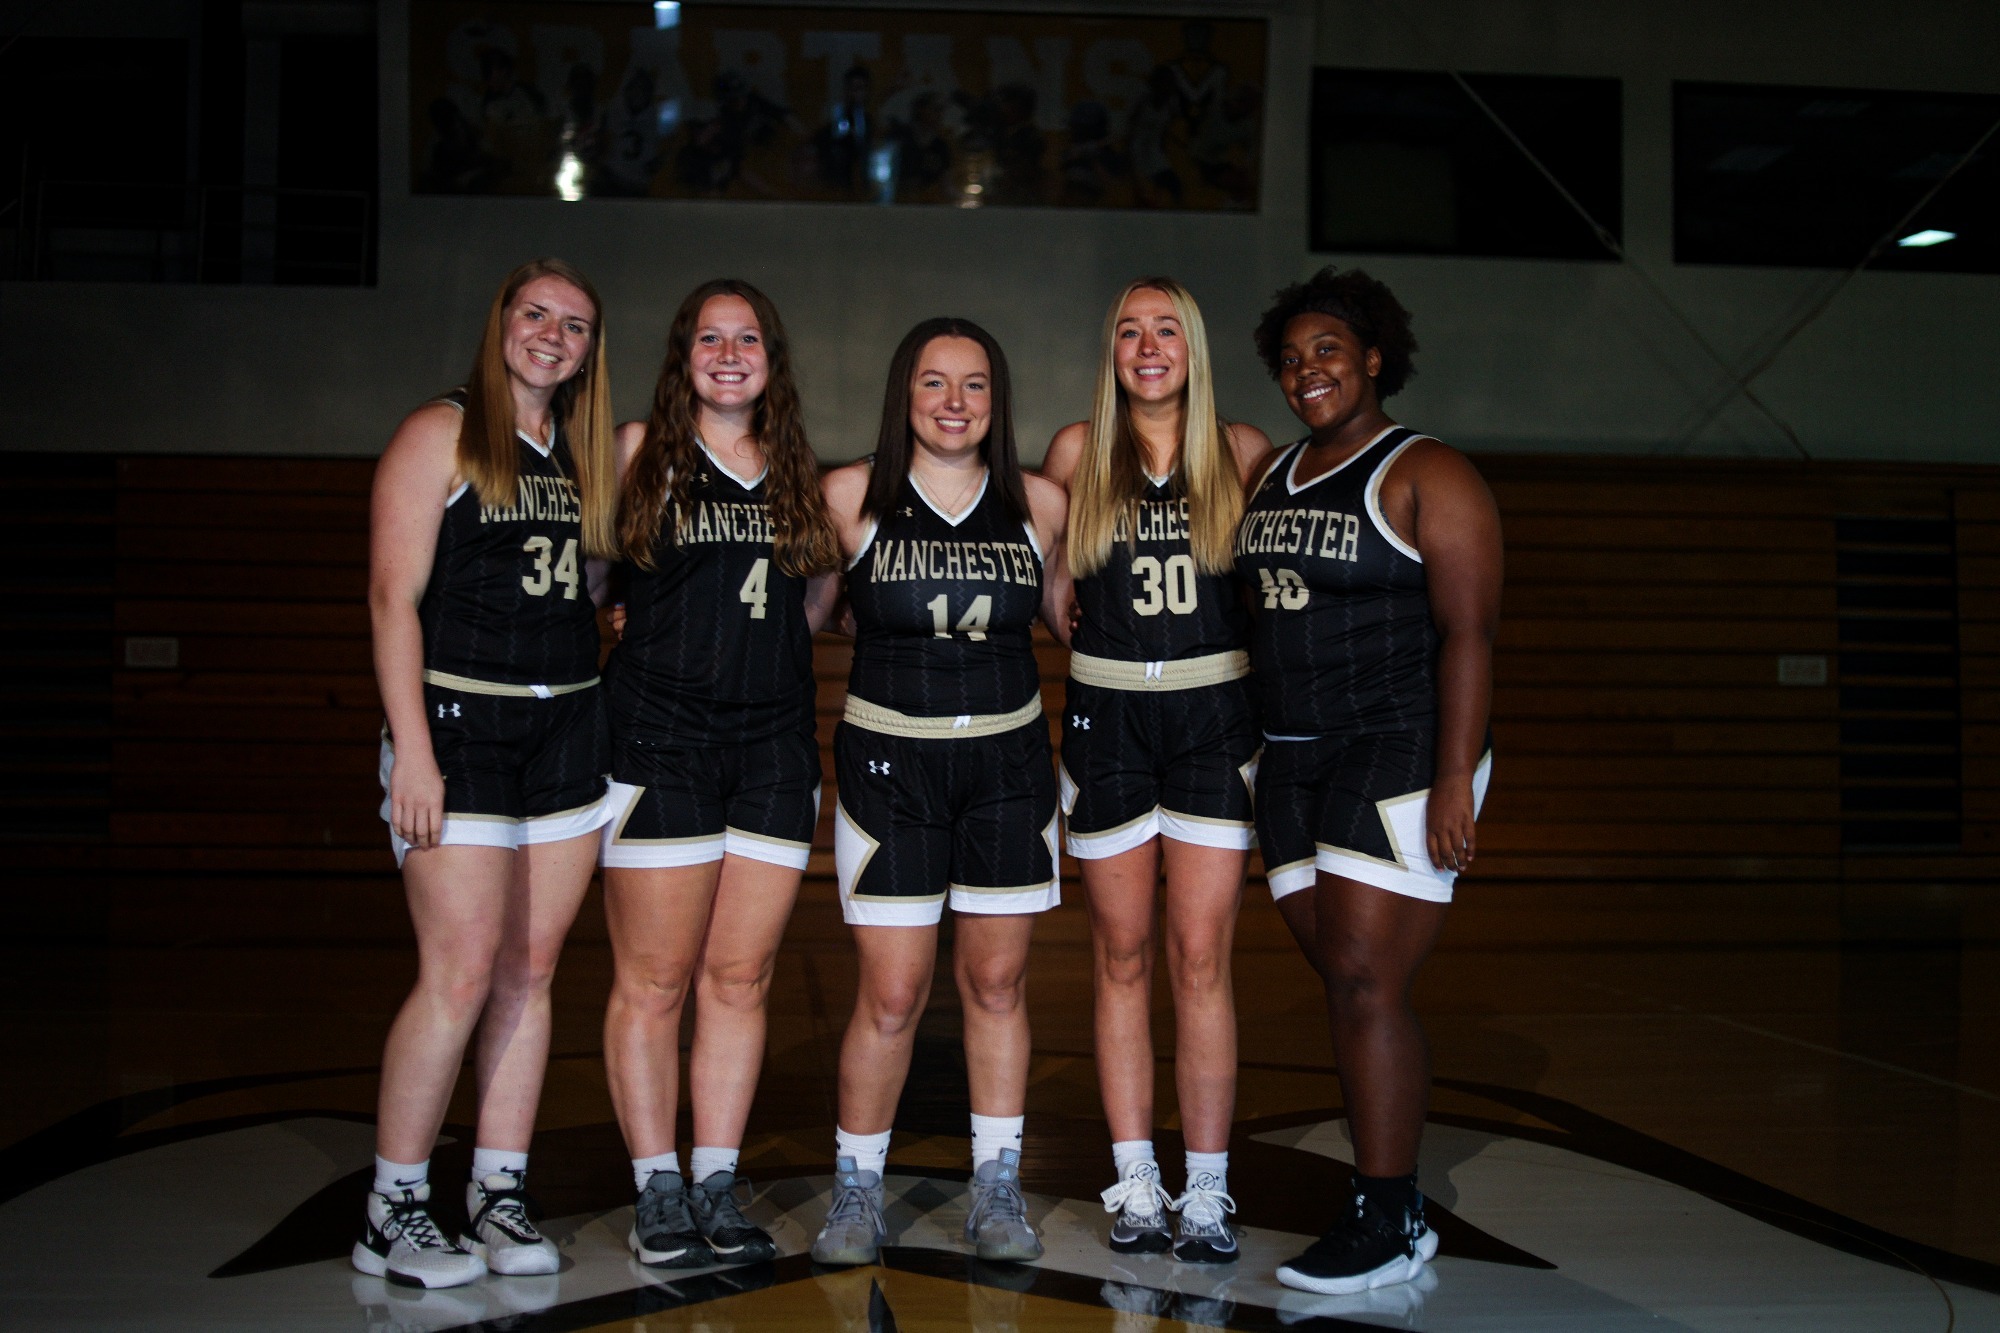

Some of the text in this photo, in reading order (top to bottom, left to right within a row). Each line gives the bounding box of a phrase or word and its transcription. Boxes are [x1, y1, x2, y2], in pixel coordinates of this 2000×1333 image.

[445, 20, 1156, 140] SPARTANS
[521, 535, 579, 600] 34
[739, 558, 769, 619] 4
[870, 539, 1038, 587] MANCHESTER
[1131, 554, 1198, 617] 30
[926, 593, 992, 642] 14
